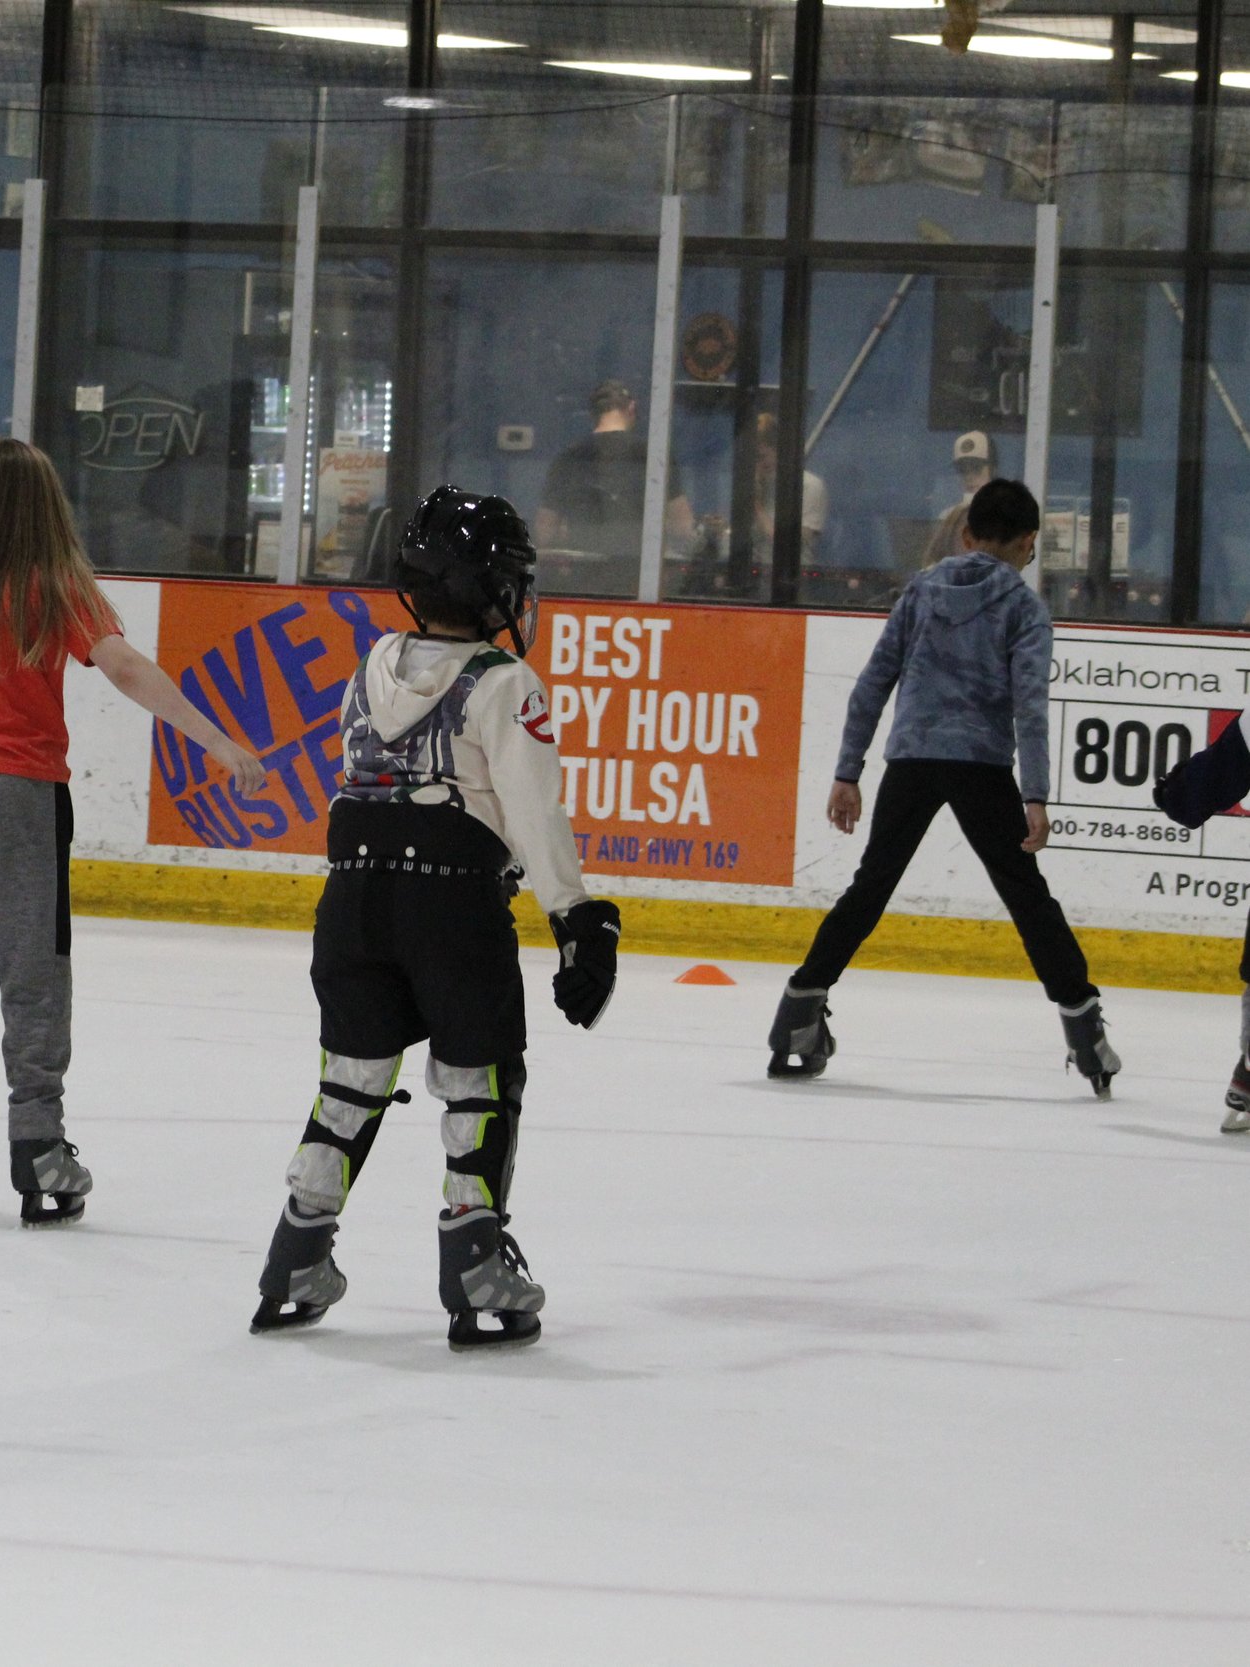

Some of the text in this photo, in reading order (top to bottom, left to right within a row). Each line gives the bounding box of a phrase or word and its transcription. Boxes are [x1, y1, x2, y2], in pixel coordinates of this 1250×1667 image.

[551, 613, 672, 681] BEST
[152, 601, 350, 798] DAVE
[626, 688, 760, 757] HOUR
[175, 717, 346, 850] BUSTE
[1073, 717, 1192, 787] 800
[561, 756, 712, 826] TULSA
[597, 834, 640, 863] AND
[647, 837, 694, 866] HWY
[703, 840, 739, 869] 169
[1051, 818, 1191, 844] 00-784-8669
[1146, 871, 1250, 907] A Progr
